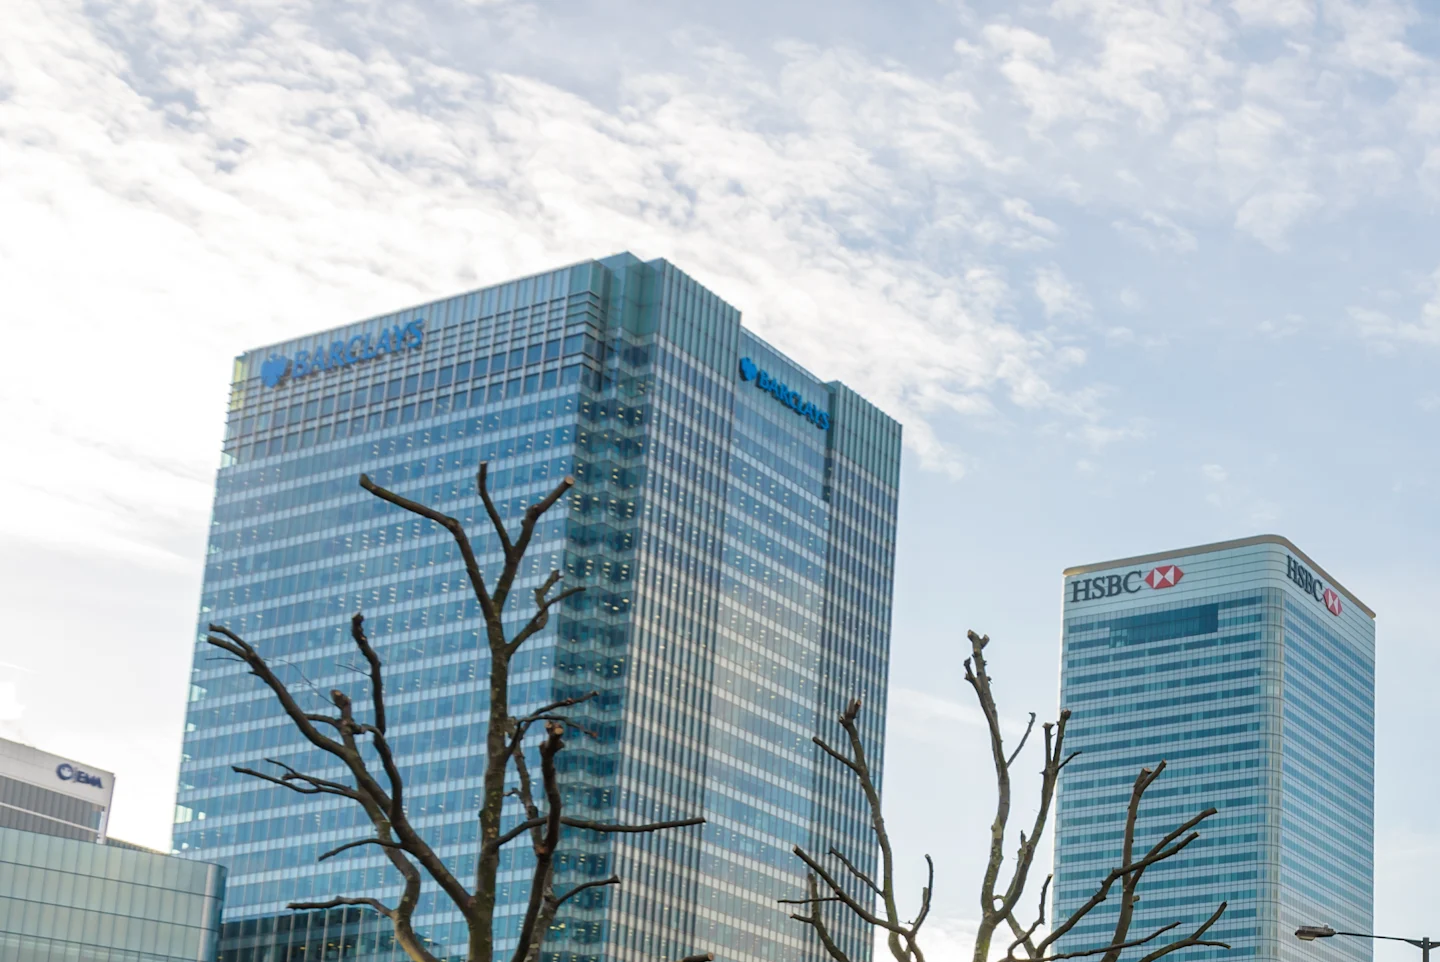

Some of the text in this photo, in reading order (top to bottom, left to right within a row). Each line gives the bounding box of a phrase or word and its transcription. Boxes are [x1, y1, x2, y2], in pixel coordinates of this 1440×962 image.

[292, 318, 425, 379] BARCLAYS
[757, 369, 829, 430] BARCLAYS
[1071, 570, 1142, 602] HSBC
[1286, 554, 1323, 602] HSBC
